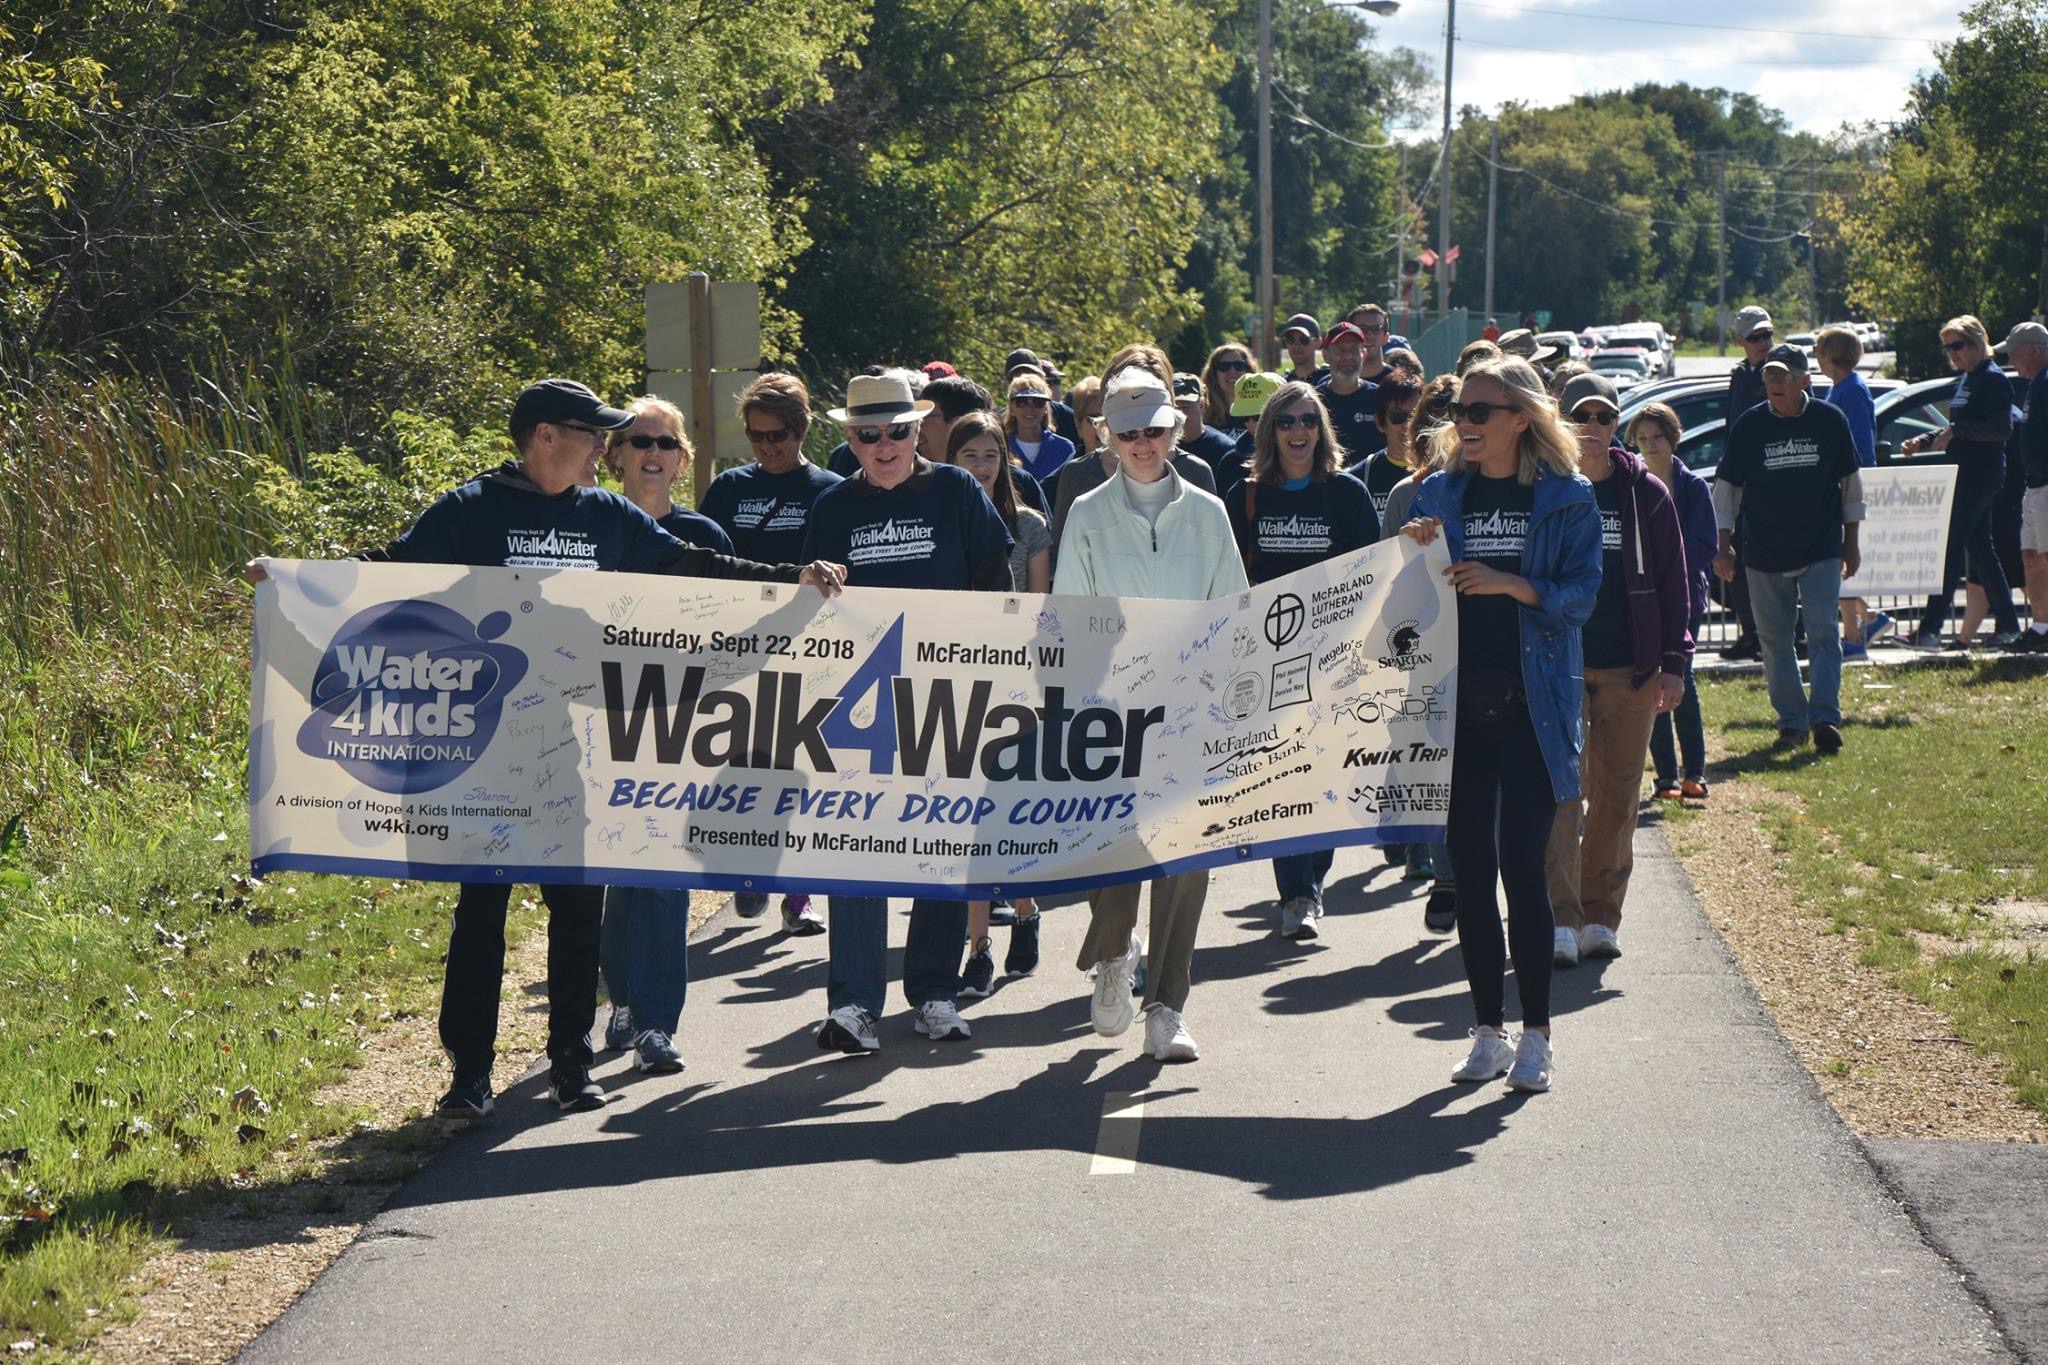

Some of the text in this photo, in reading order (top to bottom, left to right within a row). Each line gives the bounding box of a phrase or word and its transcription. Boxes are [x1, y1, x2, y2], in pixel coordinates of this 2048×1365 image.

[850, 517, 934, 548] Walk4Water
[1258, 514, 1331, 536] Walk4Water
[1464, 508, 1529, 536] alk4Wat
[507, 527, 598, 557] Walk4Water
[1311, 573, 1374, 603] McFARLAND
[1311, 591, 1363, 617] LUTHERAN
[1311, 607, 1355, 629] CHURCH
[1088, 616, 1128, 635] RICK
[602, 624, 703, 654] Saturday,
[710, 631, 759, 657] Sept
[764, 634, 797, 660] 22,
[803, 637, 855, 660] 2018
[917, 641, 1065, 670] McFarland, WI
[1318, 639, 1363, 671] Angelo's
[335, 644, 484, 691] Water
[1378, 653, 1433, 669] SPARTAN
[1422, 684, 1447, 696] DU
[1333, 697, 1448, 726] MONDE
[1382, 715, 1408, 724] salon
[1413, 714, 1430, 722] and
[327, 740, 475, 763] INTERNATIONAL
[1202, 723, 1280, 757] McFarland
[1225, 740, 1307, 780] State Bank
[1234, 776, 1273, 798] street
[275, 794, 532, 818] A division of Hope 4 Kids International
[608, 778, 1137, 825] BECAUSE EVERY DROP COUNTS
[364, 817, 449, 840] w4ki.org
[688, 826, 779, 848] Presented
[784, 831, 805, 852] by
[812, 833, 907, 854] McFarland
[913, 837, 992, 856] Lutheran
[997, 839, 1059, 856] Church
